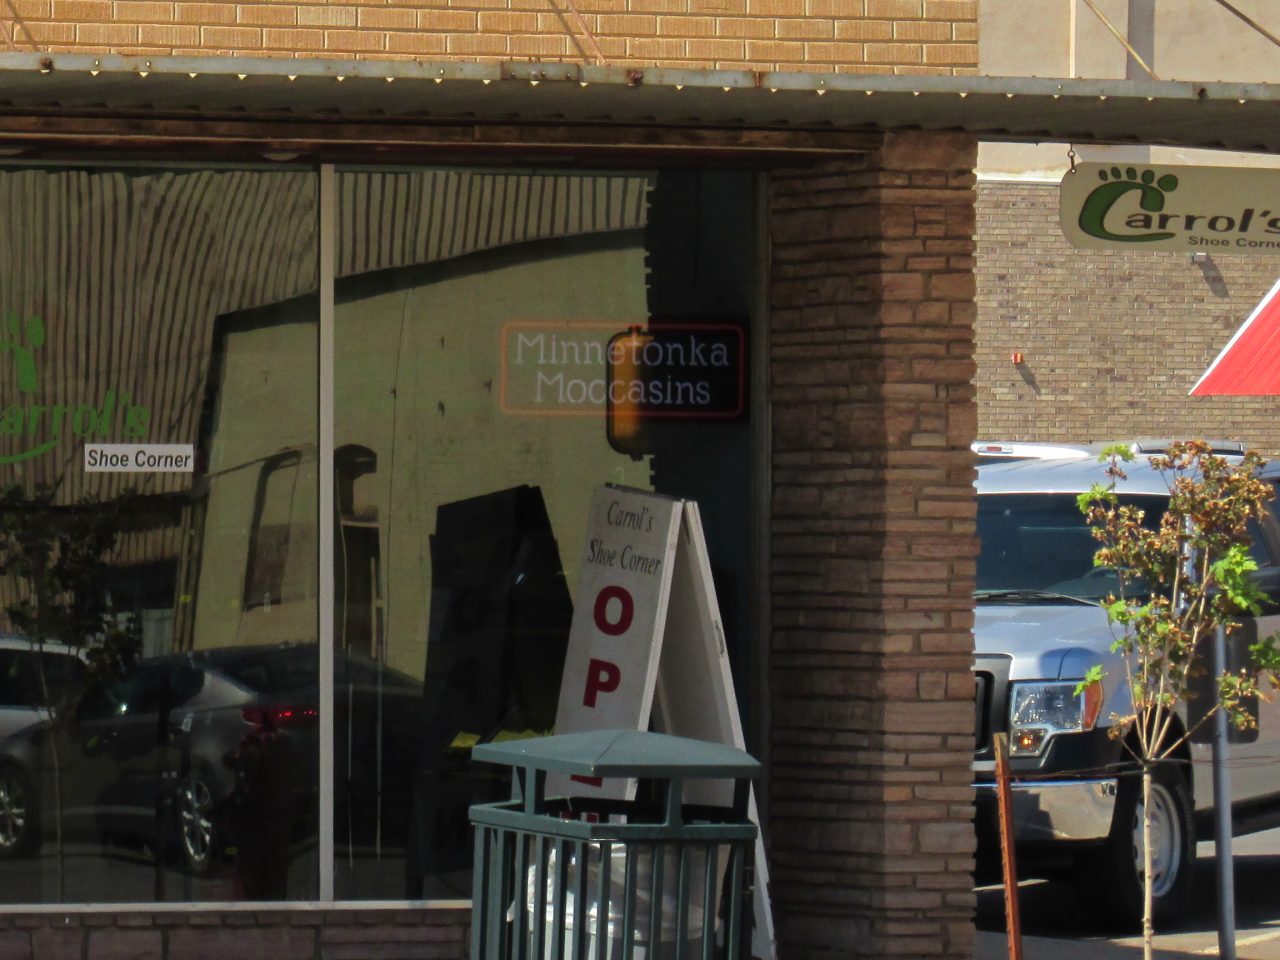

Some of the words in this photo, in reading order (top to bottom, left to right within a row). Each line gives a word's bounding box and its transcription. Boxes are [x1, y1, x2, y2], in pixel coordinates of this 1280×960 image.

[1078, 181, 1280, 242] Carrol's
[1188, 236, 1230, 247] Shoe
[1236, 238, 1280, 248] Corn
[515, 333, 729, 367] Minnetonka
[534, 371, 710, 405] Moccasins
[87, 449, 129, 467] Shoe
[134, 450, 191, 468] Corner
[607, 500, 654, 531] Carrol's
[588, 539, 617, 567] Shoe
[620, 545, 661, 575] Corner
